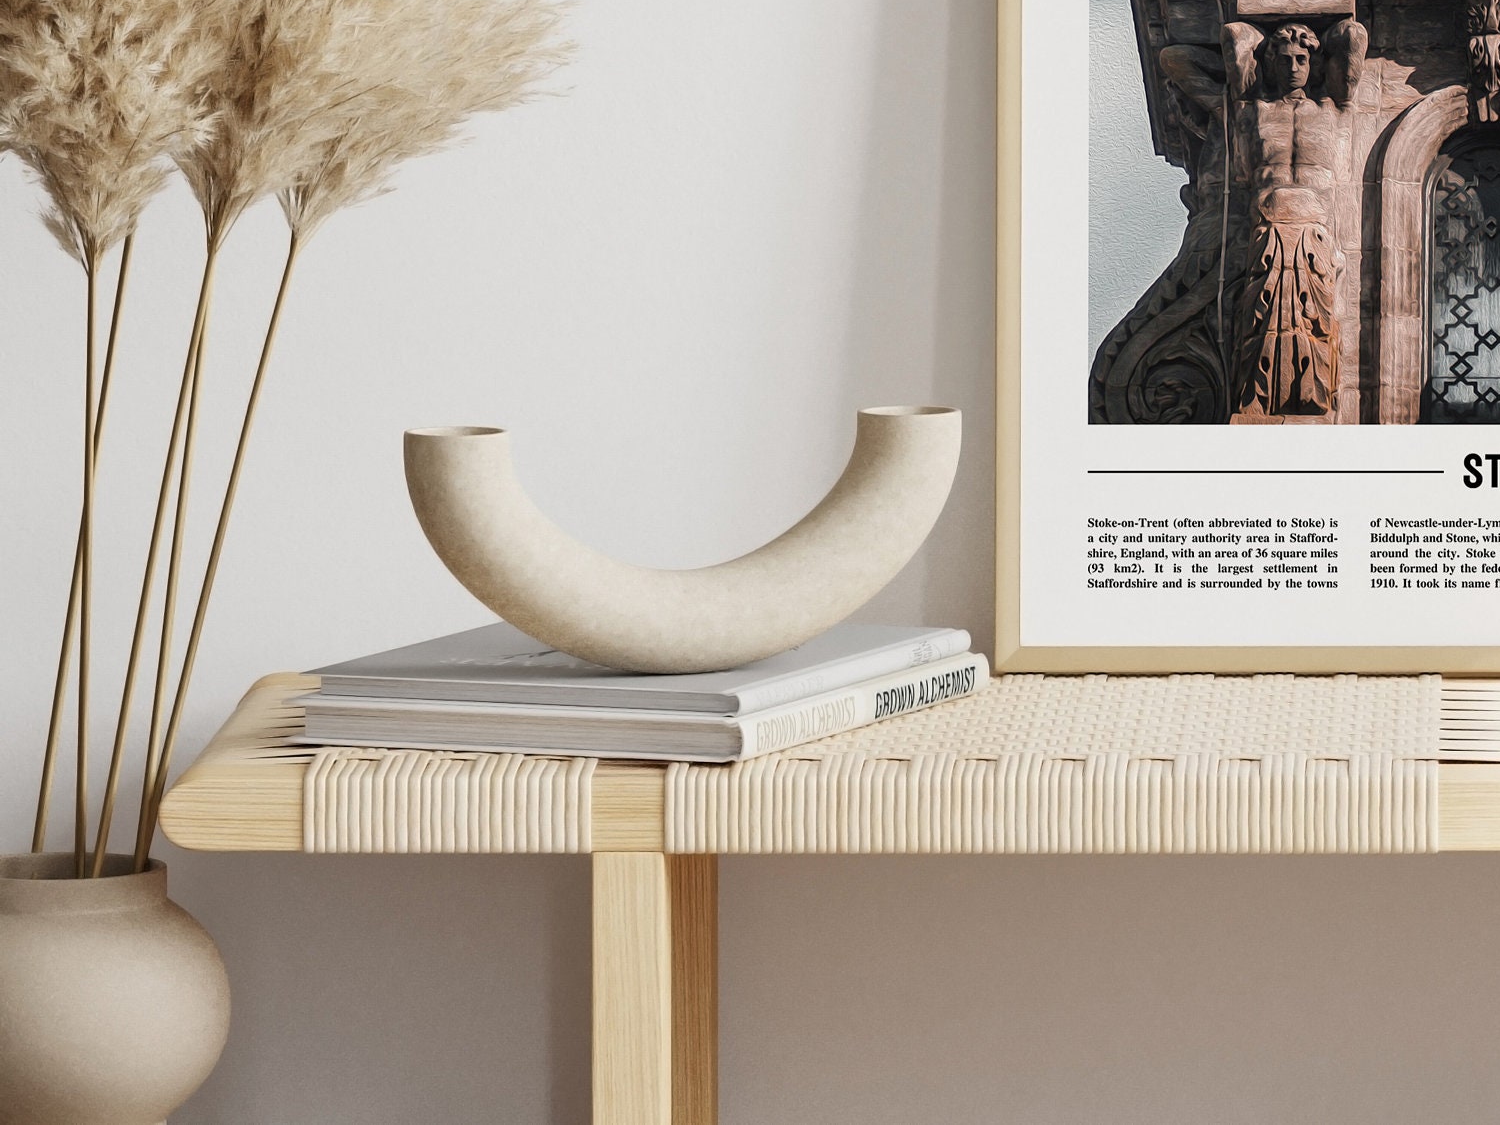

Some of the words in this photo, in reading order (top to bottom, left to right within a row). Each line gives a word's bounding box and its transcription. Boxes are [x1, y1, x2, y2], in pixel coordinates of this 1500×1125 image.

[1087, 518, 1169, 527] Stoke-on-Trent
[1172, 518, 1205, 529] (often
[1208, 518, 1272, 528] abbreviated
[1276, 519, 1288, 527] to
[1290, 518, 1326, 529] Stoke)
[1329, 518, 1339, 527] is
[1369, 518, 1383, 527] of
[1098, 533, 1119, 545] city
[1122, 533, 1143, 543] and
[1147, 533, 1188, 545] unitary
[1191, 533, 1242, 545] authority
[1274, 533, 1286, 542] in
[1289, 533, 1339, 543] Stafford-
[1370, 533, 1420, 545] Biddulph
[1422, 533, 1443, 543] and
[1445, 533, 1480, 544] Stone,
[1087, 548, 1118, 560] shire,
[1120, 548, 1169, 560] England,
[1171, 548, 1195, 558] with
[1241, 548, 1254, 558] of
[1254, 548, 1269, 558] 36
[1270, 551, 1308, 560] square
[1310, 548, 1339, 558] miles
[1369, 548, 1409, 558] around
[1414, 548, 1432, 558] the
[1437, 548, 1461, 560] city.
[1465, 548, 1496, 558] Stoke
[1087, 563, 1105, 574] (93
[1113, 563, 1145, 574] km2).
[1154, 564, 1164, 573] It
[1173, 564, 1182, 573] is
[1191, 564, 1209, 573] the
[1217, 564, 1254, 575] largest
[1262, 563, 1319, 573] settlement
[1327, 564, 1339, 573] in
[1369, 564, 1395, 573] been
[1399, 563, 1438, 573] formed
[1442, 564, 1456, 575] by
[1460, 564, 1478, 573] the
[1087, 579, 1158, 588] Staffordshire
[1162, 579, 1183, 588] and
[1187, 579, 1197, 588] is
[1199, 579, 1263, 588] surrounded
[1267, 579, 1281, 590] by
[1285, 579, 1303, 588] the
[1306, 580, 1339, 588] towns
[1370, 579, 1399, 588] 1910.
[1402, 579, 1412, 588] It
[1416, 579, 1440, 588] took
[1444, 579, 1458, 588] its
[874, 683, 915, 719] GROWN
[917, 666, 976, 706] ALCHEMIST
[756, 713, 797, 752] GROWN
[799, 696, 856, 739] ALCHEMIST
